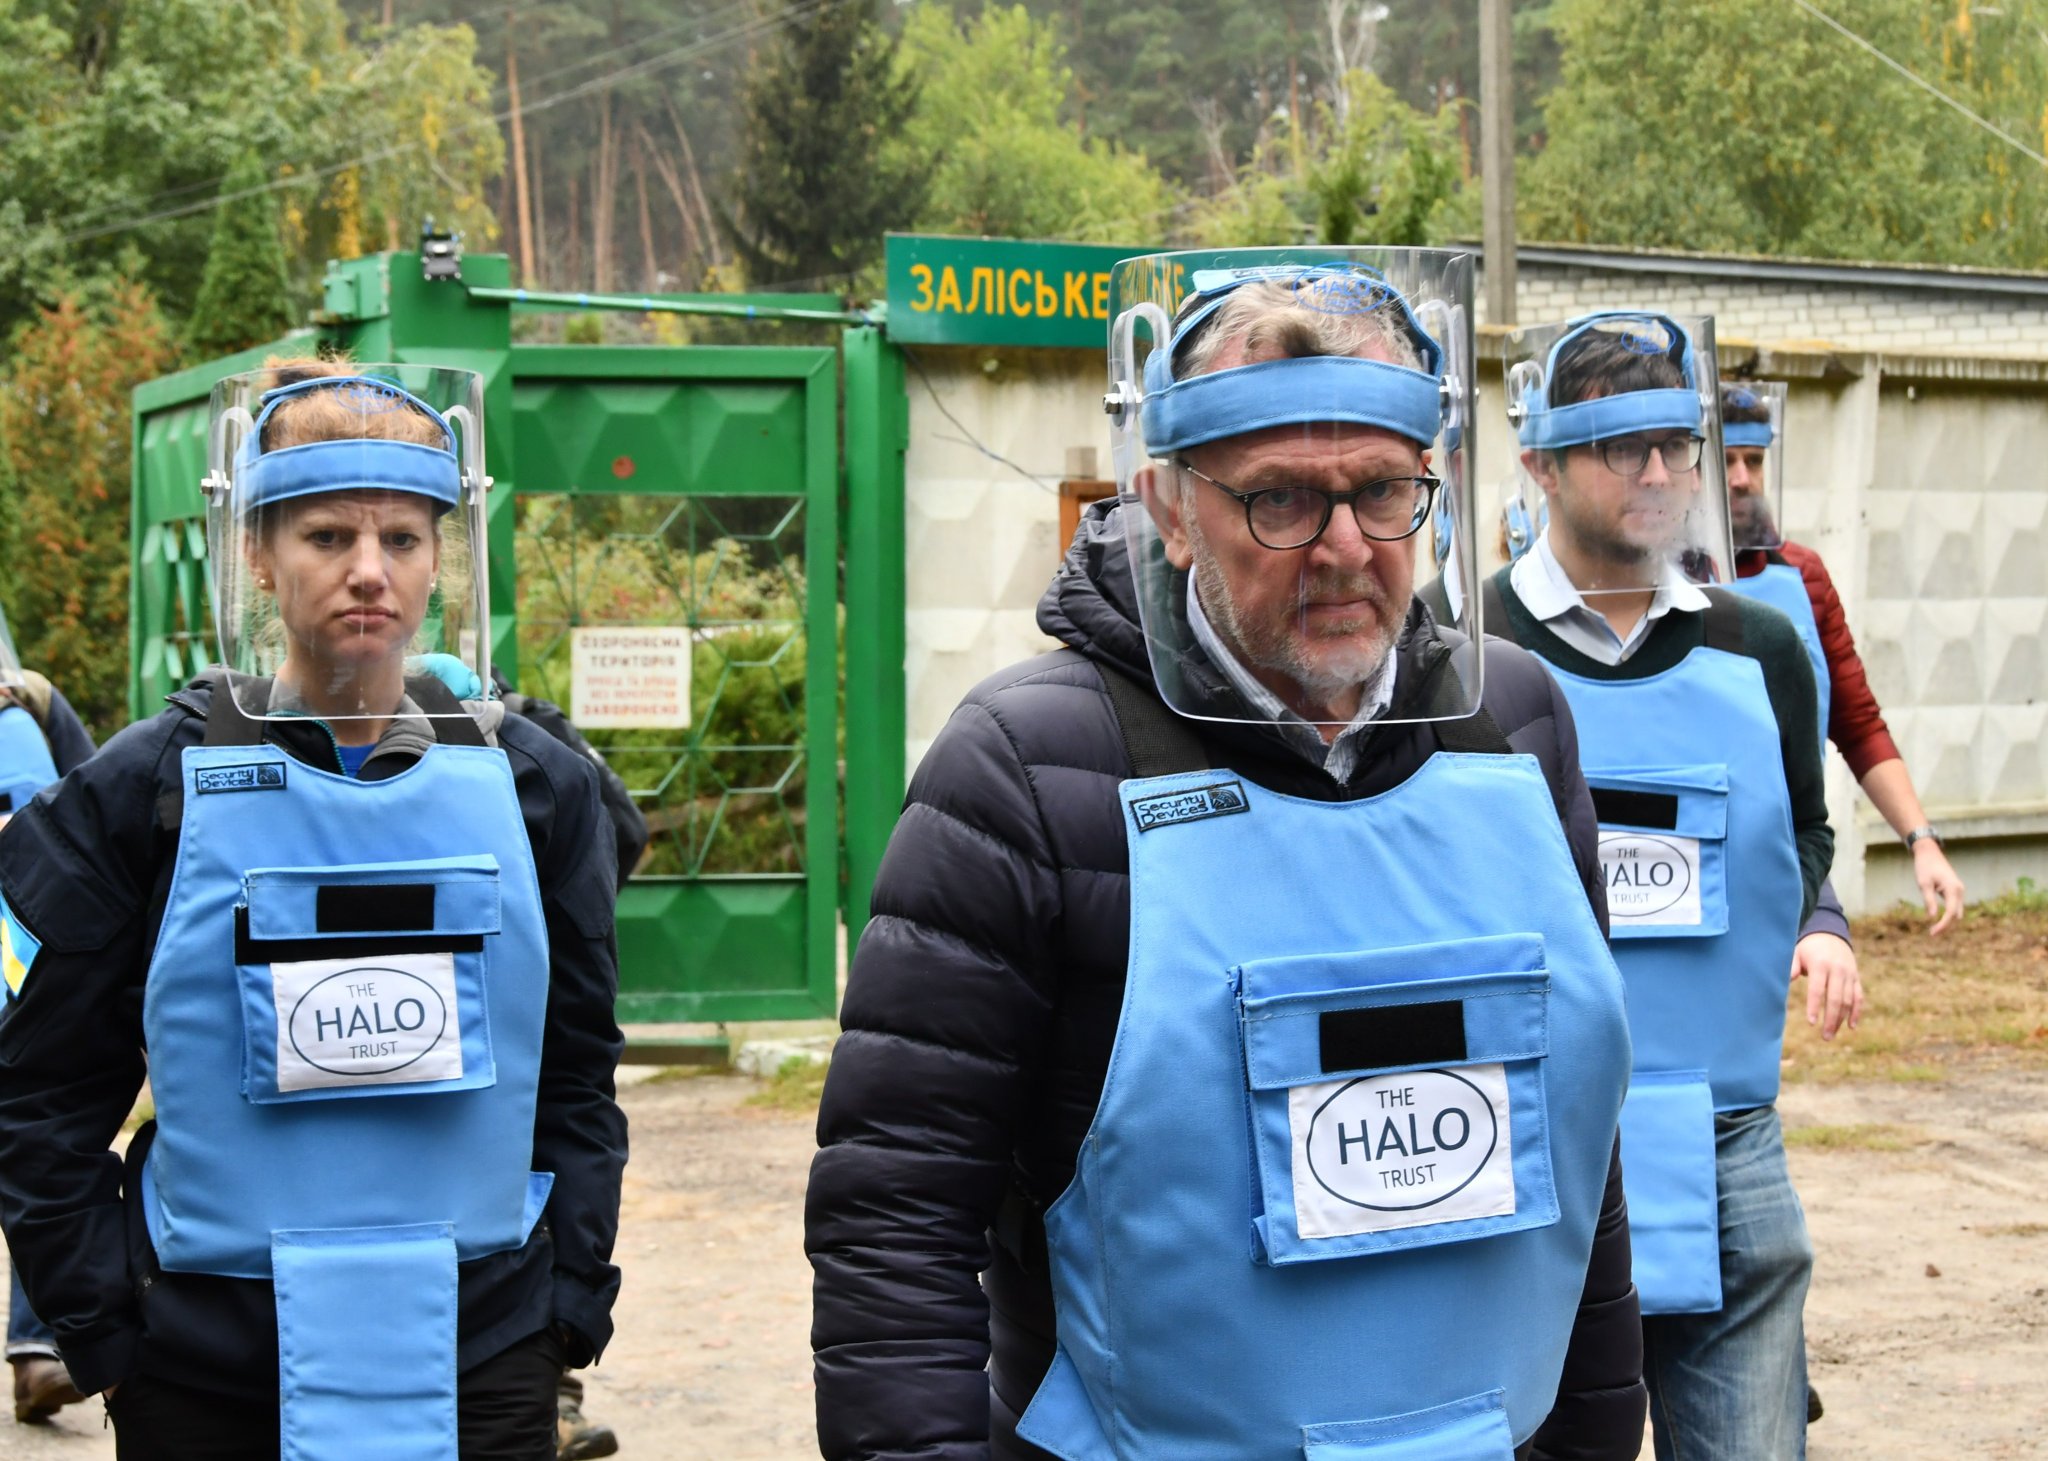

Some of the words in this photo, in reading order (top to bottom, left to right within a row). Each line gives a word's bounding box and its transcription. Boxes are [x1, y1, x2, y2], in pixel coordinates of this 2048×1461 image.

[200, 769, 254, 781] Security
[200, 777, 255, 789] Devices
[1138, 793, 1205, 814] Security
[1141, 803, 1208, 825] Devices
[1617, 848, 1639, 858] THE
[1614, 893, 1650, 904] TRUST
[346, 983, 376, 998] THE
[316, 998, 425, 1042] HALO
[350, 1041, 398, 1059] TRUST
[1376, 1087, 1415, 1109] THE
[1337, 1107, 1470, 1165] HALO
[1379, 1164, 1436, 1189] TRUST
